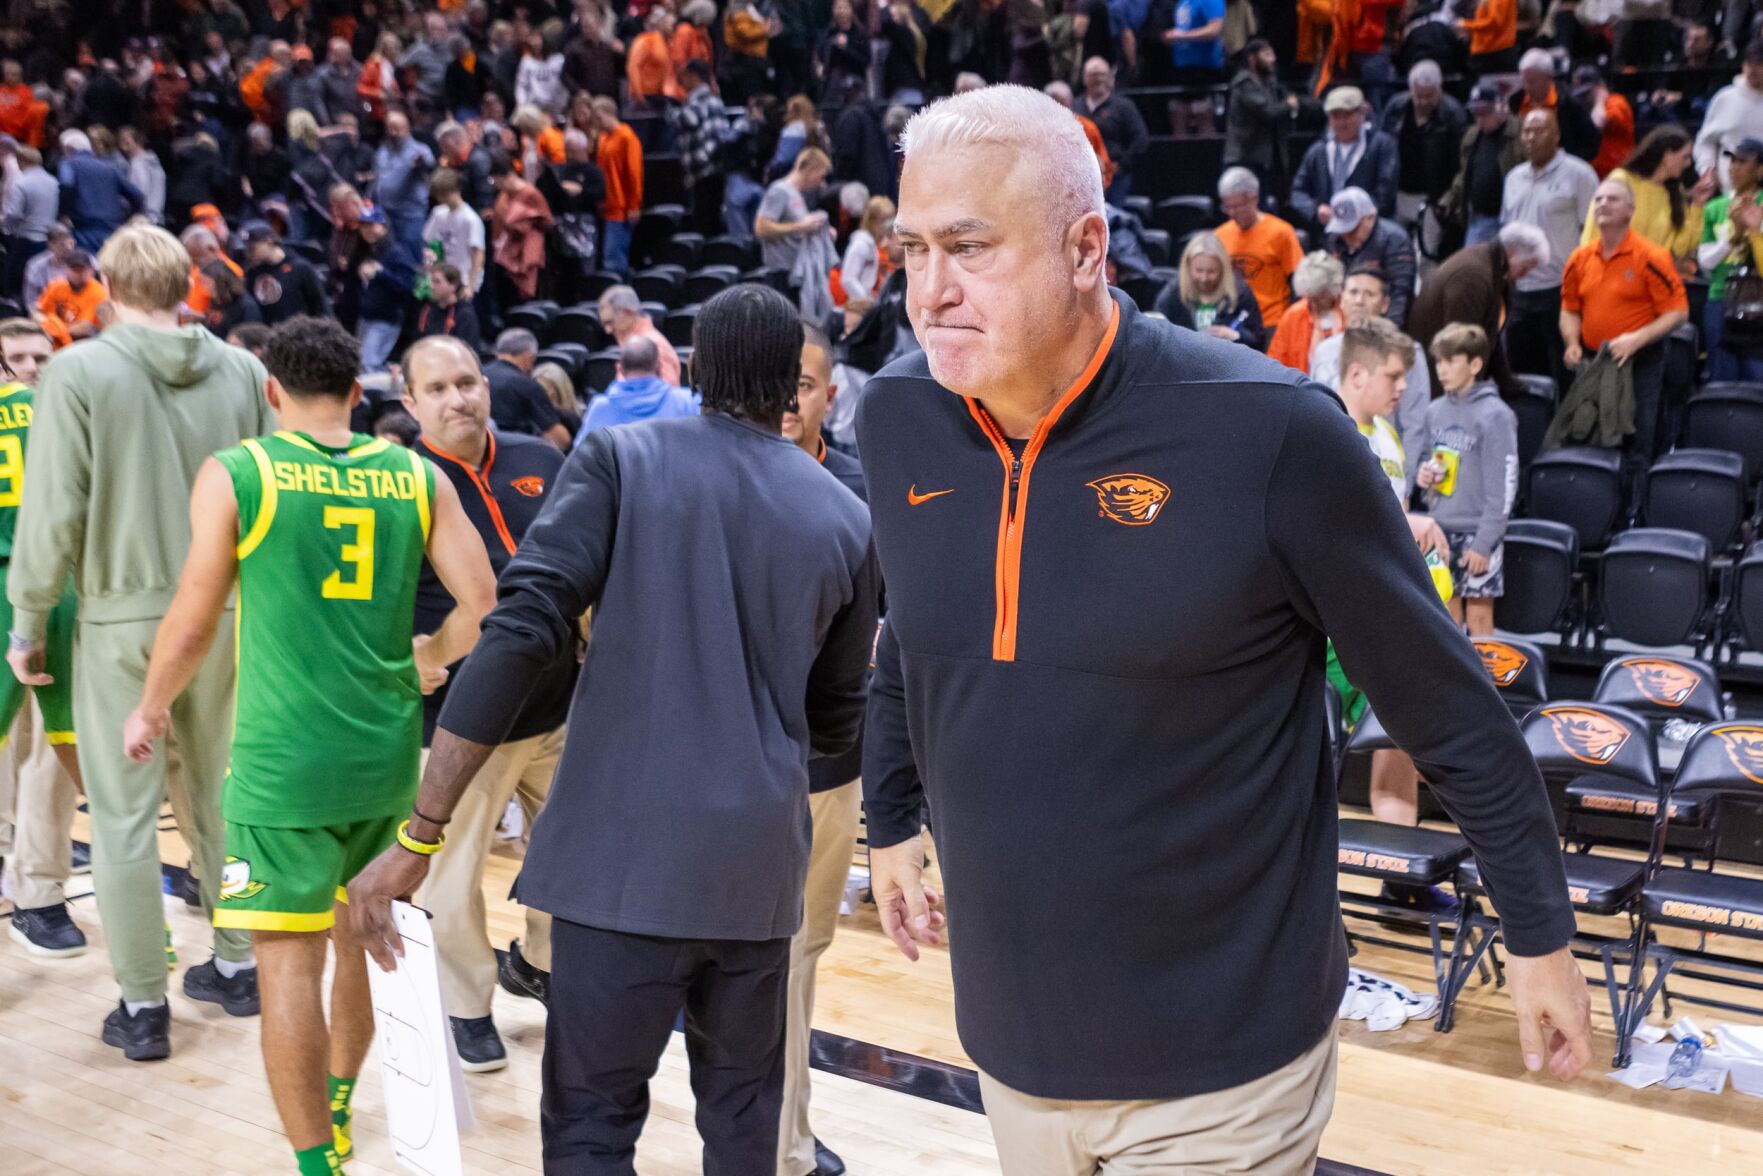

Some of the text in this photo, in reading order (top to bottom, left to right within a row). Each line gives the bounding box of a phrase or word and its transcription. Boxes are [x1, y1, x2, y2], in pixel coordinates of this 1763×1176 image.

[273, 461, 417, 500] SHELSTAD
[321, 505, 375, 600] 3
[1661, 900, 1730, 925] OREGON
